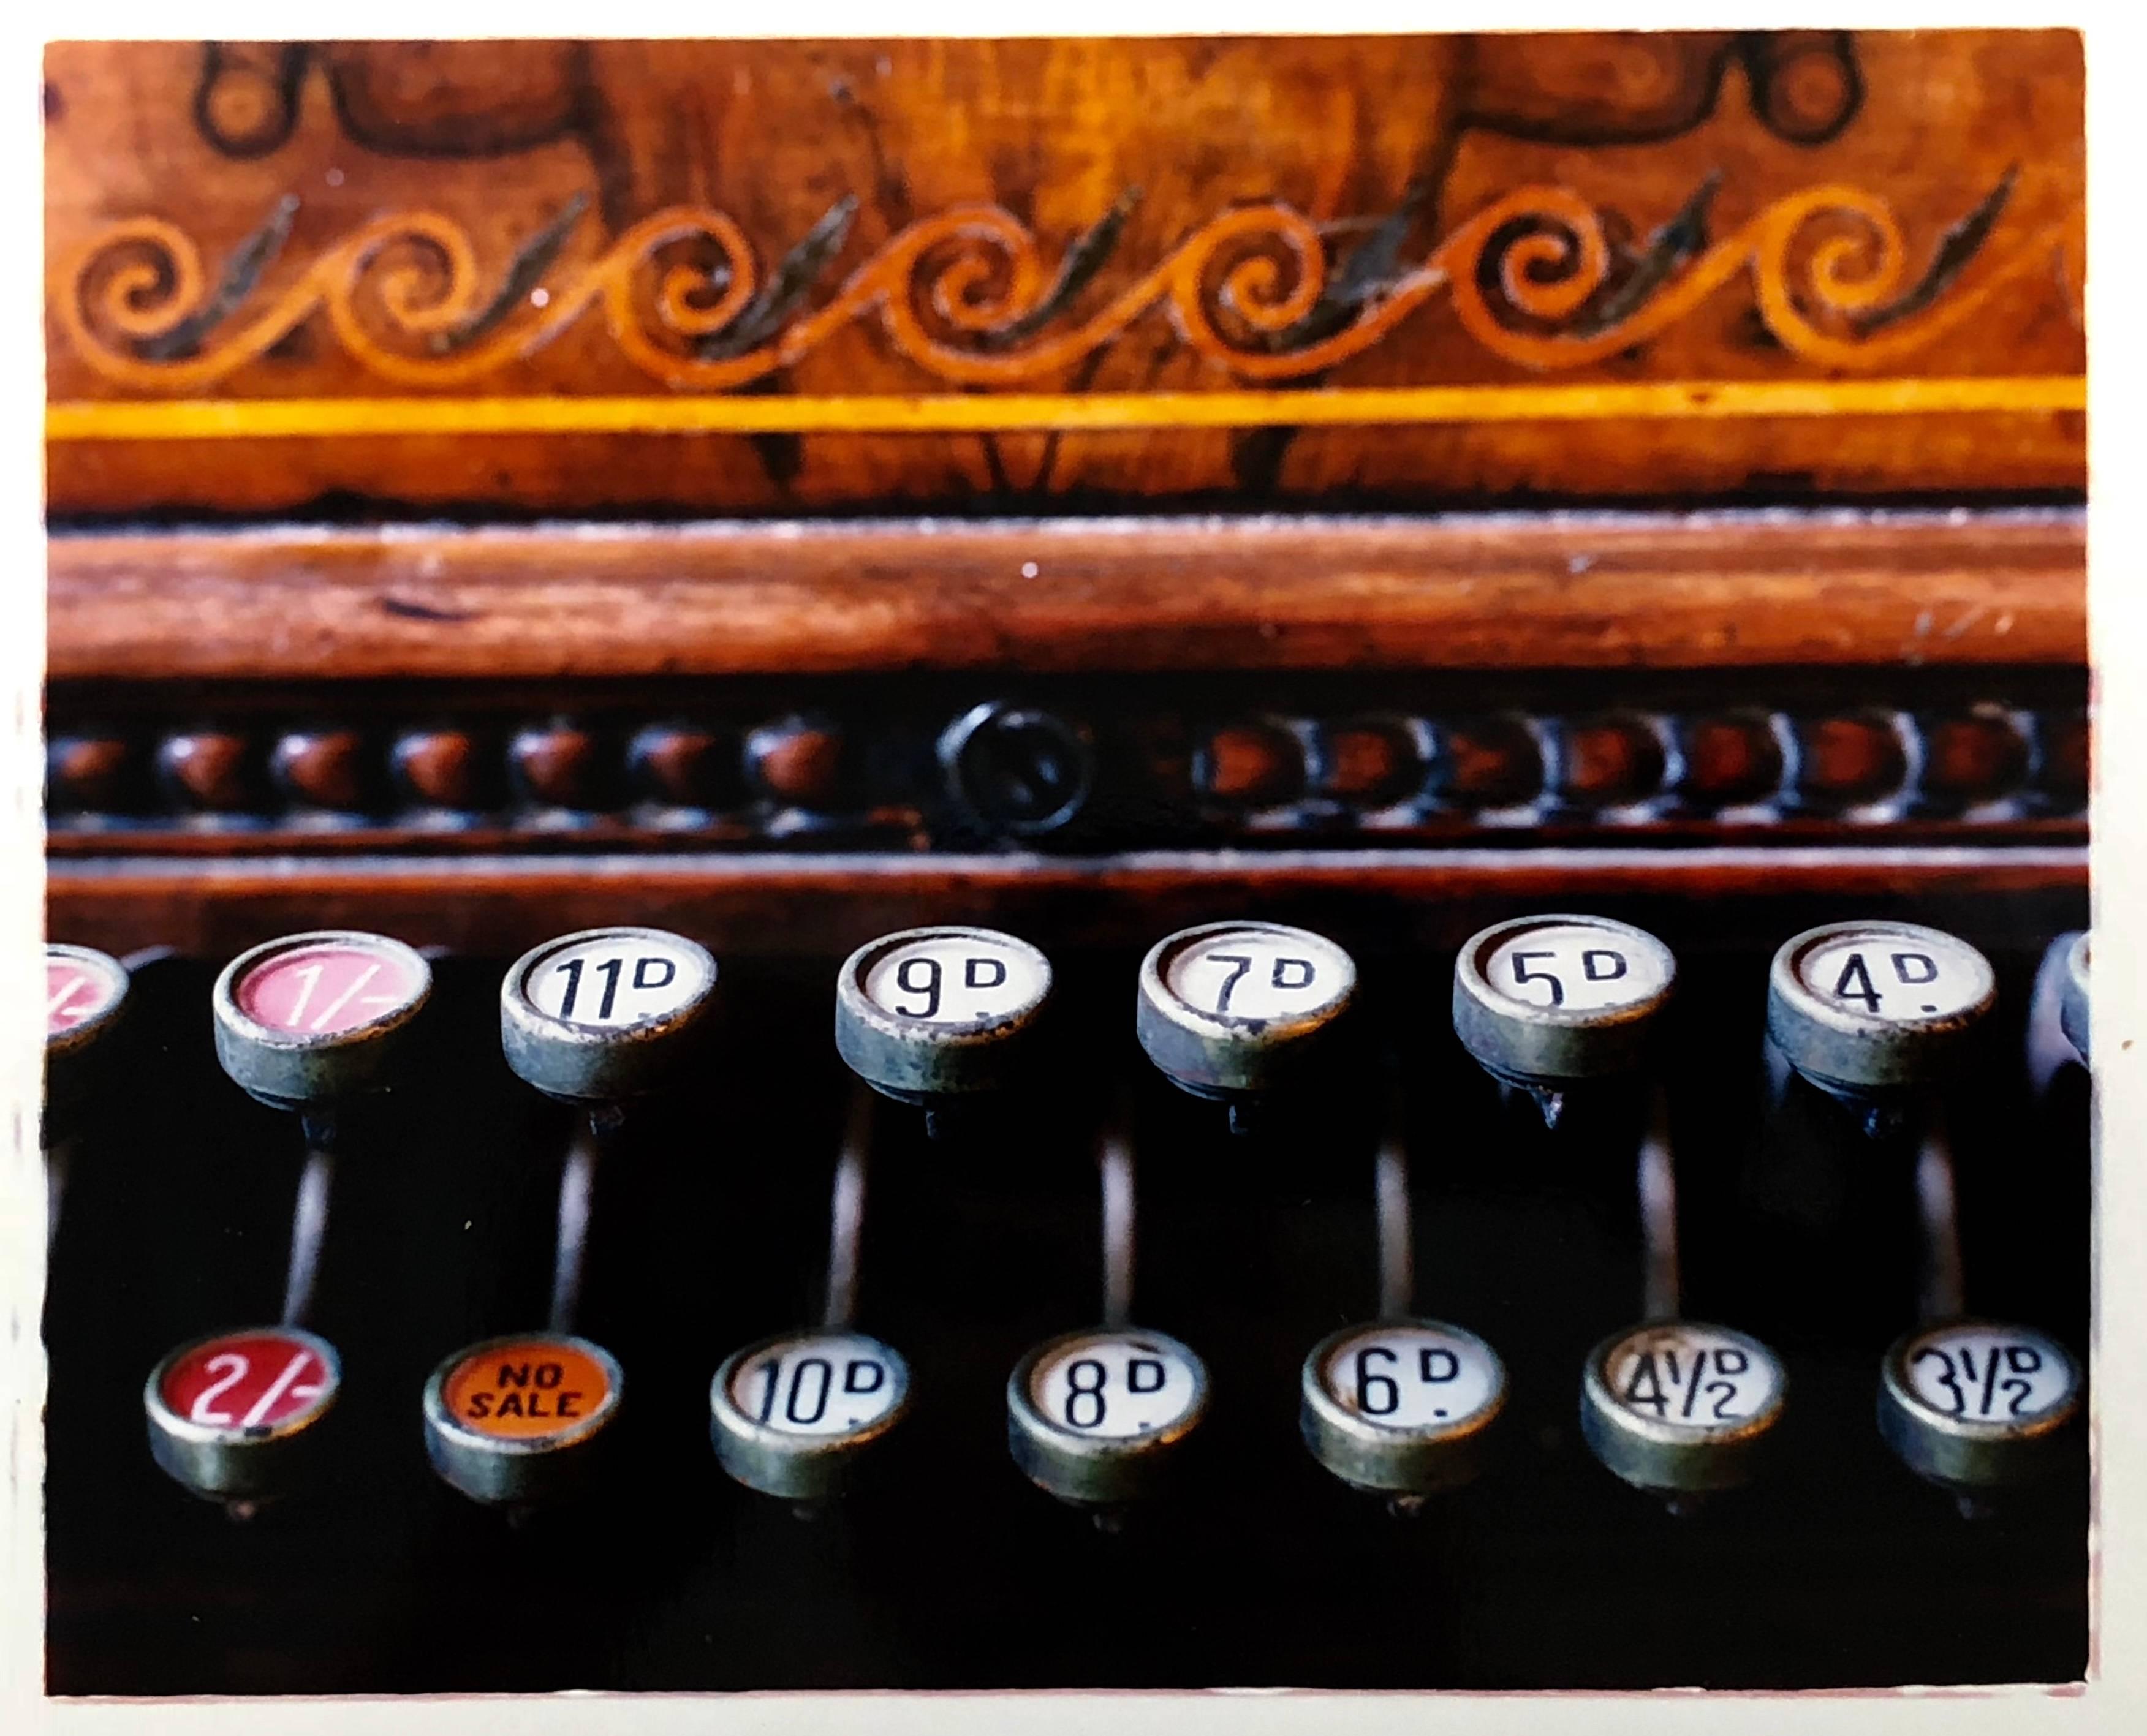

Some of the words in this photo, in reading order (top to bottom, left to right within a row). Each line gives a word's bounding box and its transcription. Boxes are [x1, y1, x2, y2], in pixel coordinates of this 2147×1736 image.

[297, 964, 398, 1029] 1/-
[192, 1354, 323, 1425] 2/-
[497, 1362, 564, 1388] NO
[468, 1392, 582, 1417] SALE
